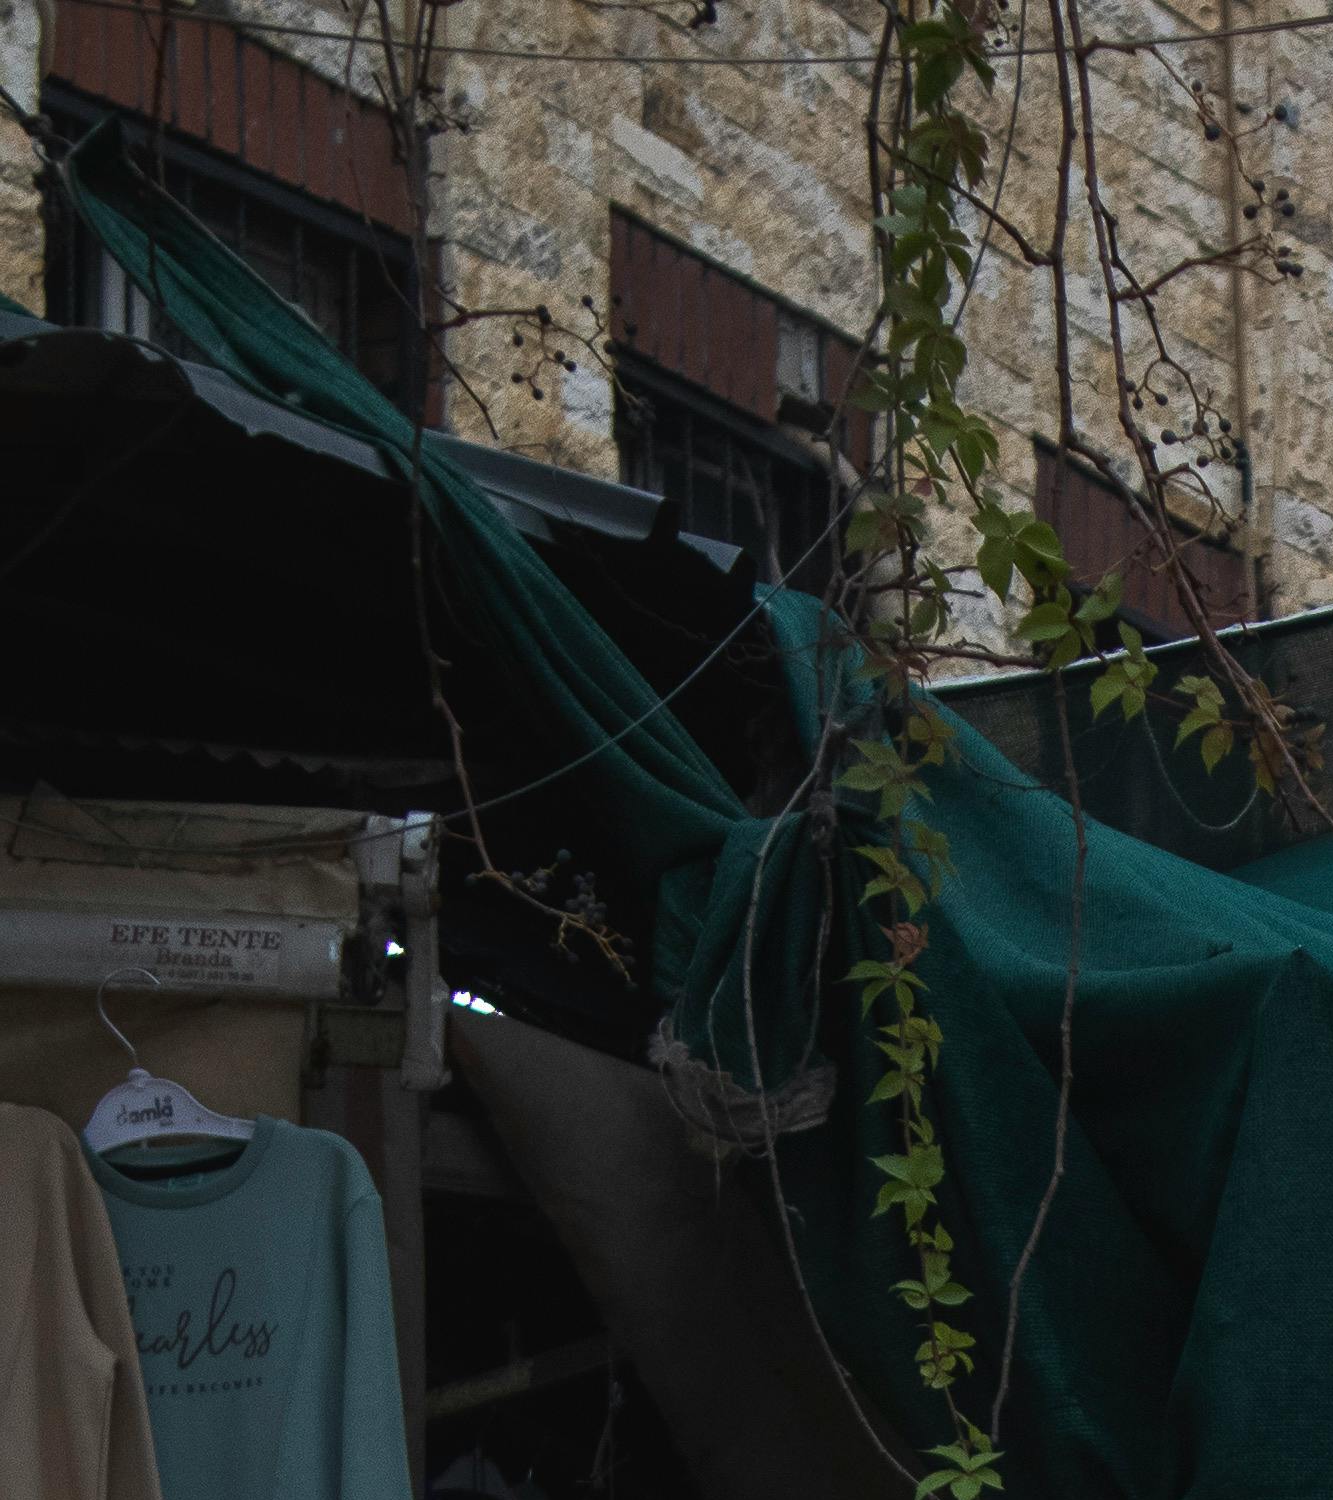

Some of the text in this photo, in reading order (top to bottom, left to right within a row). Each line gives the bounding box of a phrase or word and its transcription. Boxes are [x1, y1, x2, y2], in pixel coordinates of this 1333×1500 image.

[110, 923, 282, 950] EFE TENTE
[156, 947, 233, 968] Branda
[129, 1268, 279, 1370] earless
